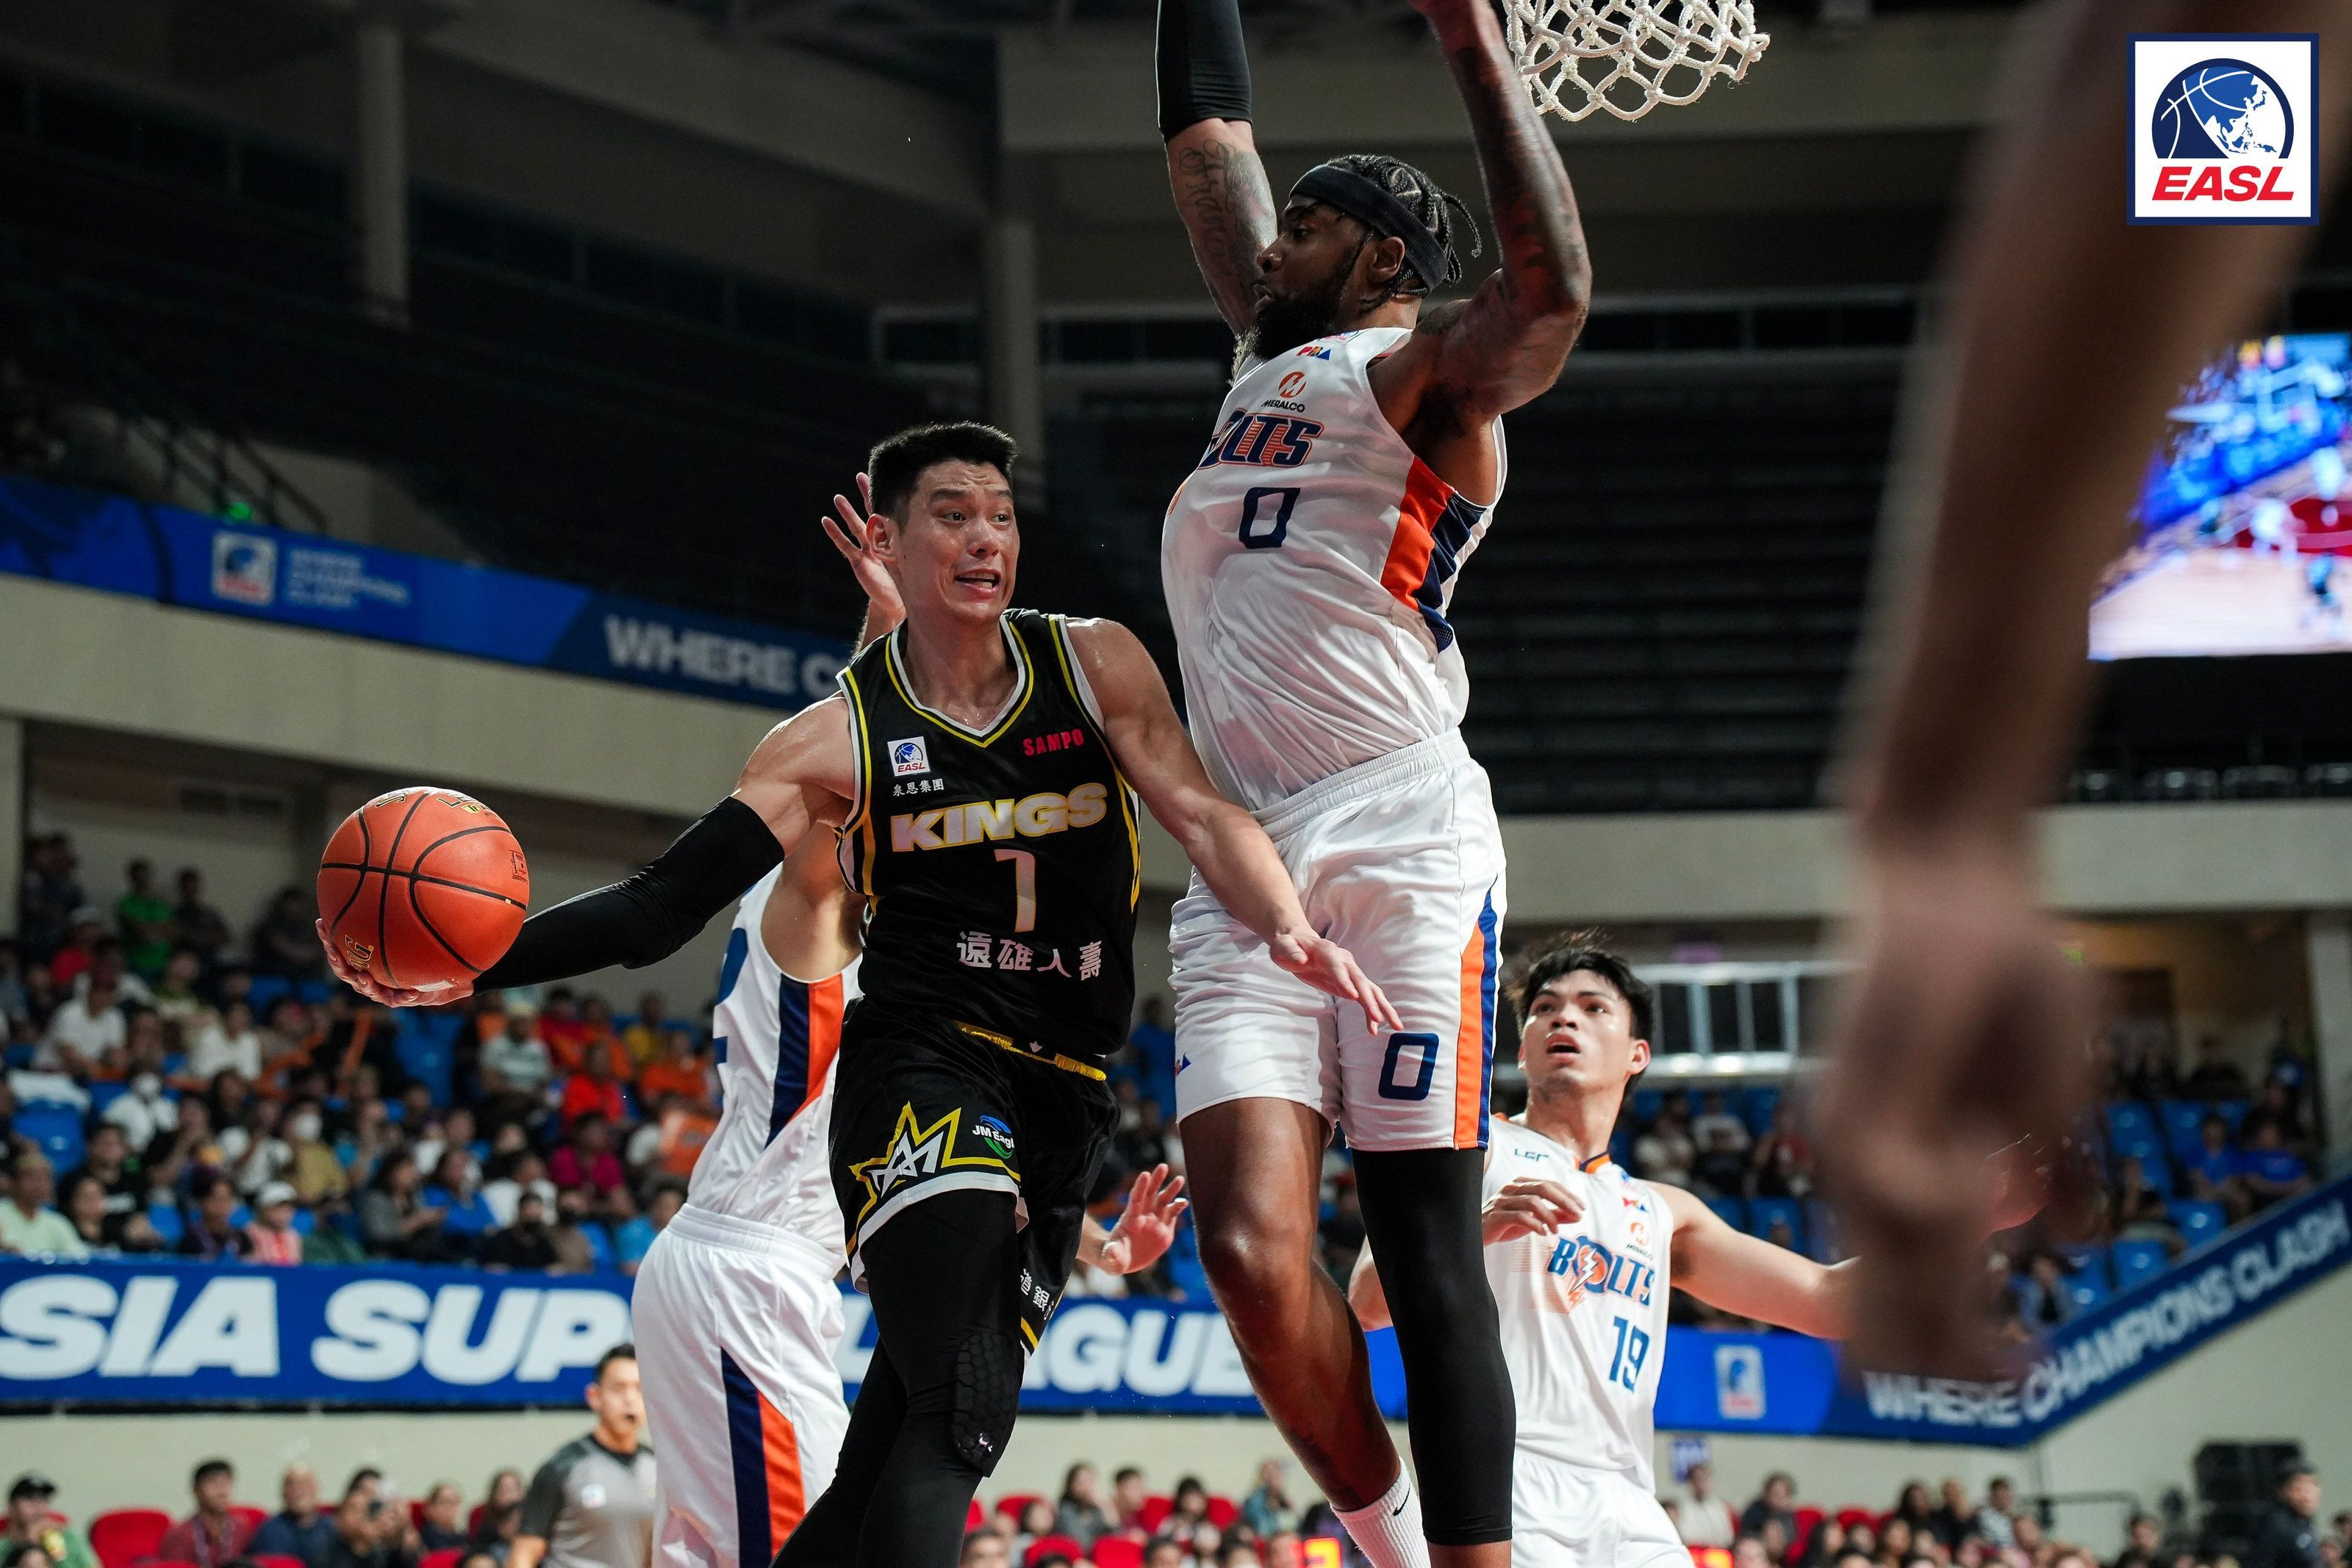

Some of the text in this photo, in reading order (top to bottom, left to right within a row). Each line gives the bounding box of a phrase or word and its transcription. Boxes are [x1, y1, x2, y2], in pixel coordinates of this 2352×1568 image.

[1261, 399, 1305, 413] MERALCO
[1239, 486, 1301, 549] 0
[604, 616, 797, 695] WHERE
[897, 763, 926, 773] EASL
[1023, 728, 1085, 756] SAMPO
[890, 783, 1108, 852] KINGS
[892, 778, 944, 797] 泉恩集團
[994, 849, 1037, 932] 7
[956, 931, 1102, 981] 遠雄人壽
[1378, 1032, 1440, 1101] 0
[972, 1124, 1015, 1149] JM Eagl
[1546, 1235, 1657, 1306] BOLTS
[0, 1273, 282, 1381] SIA
[311, 1279, 634, 1384] SUP
[1862, 1199, 2351, 1428] WHERE CHAMPIONS CLASH
[1608, 1315, 1649, 1393] 19
